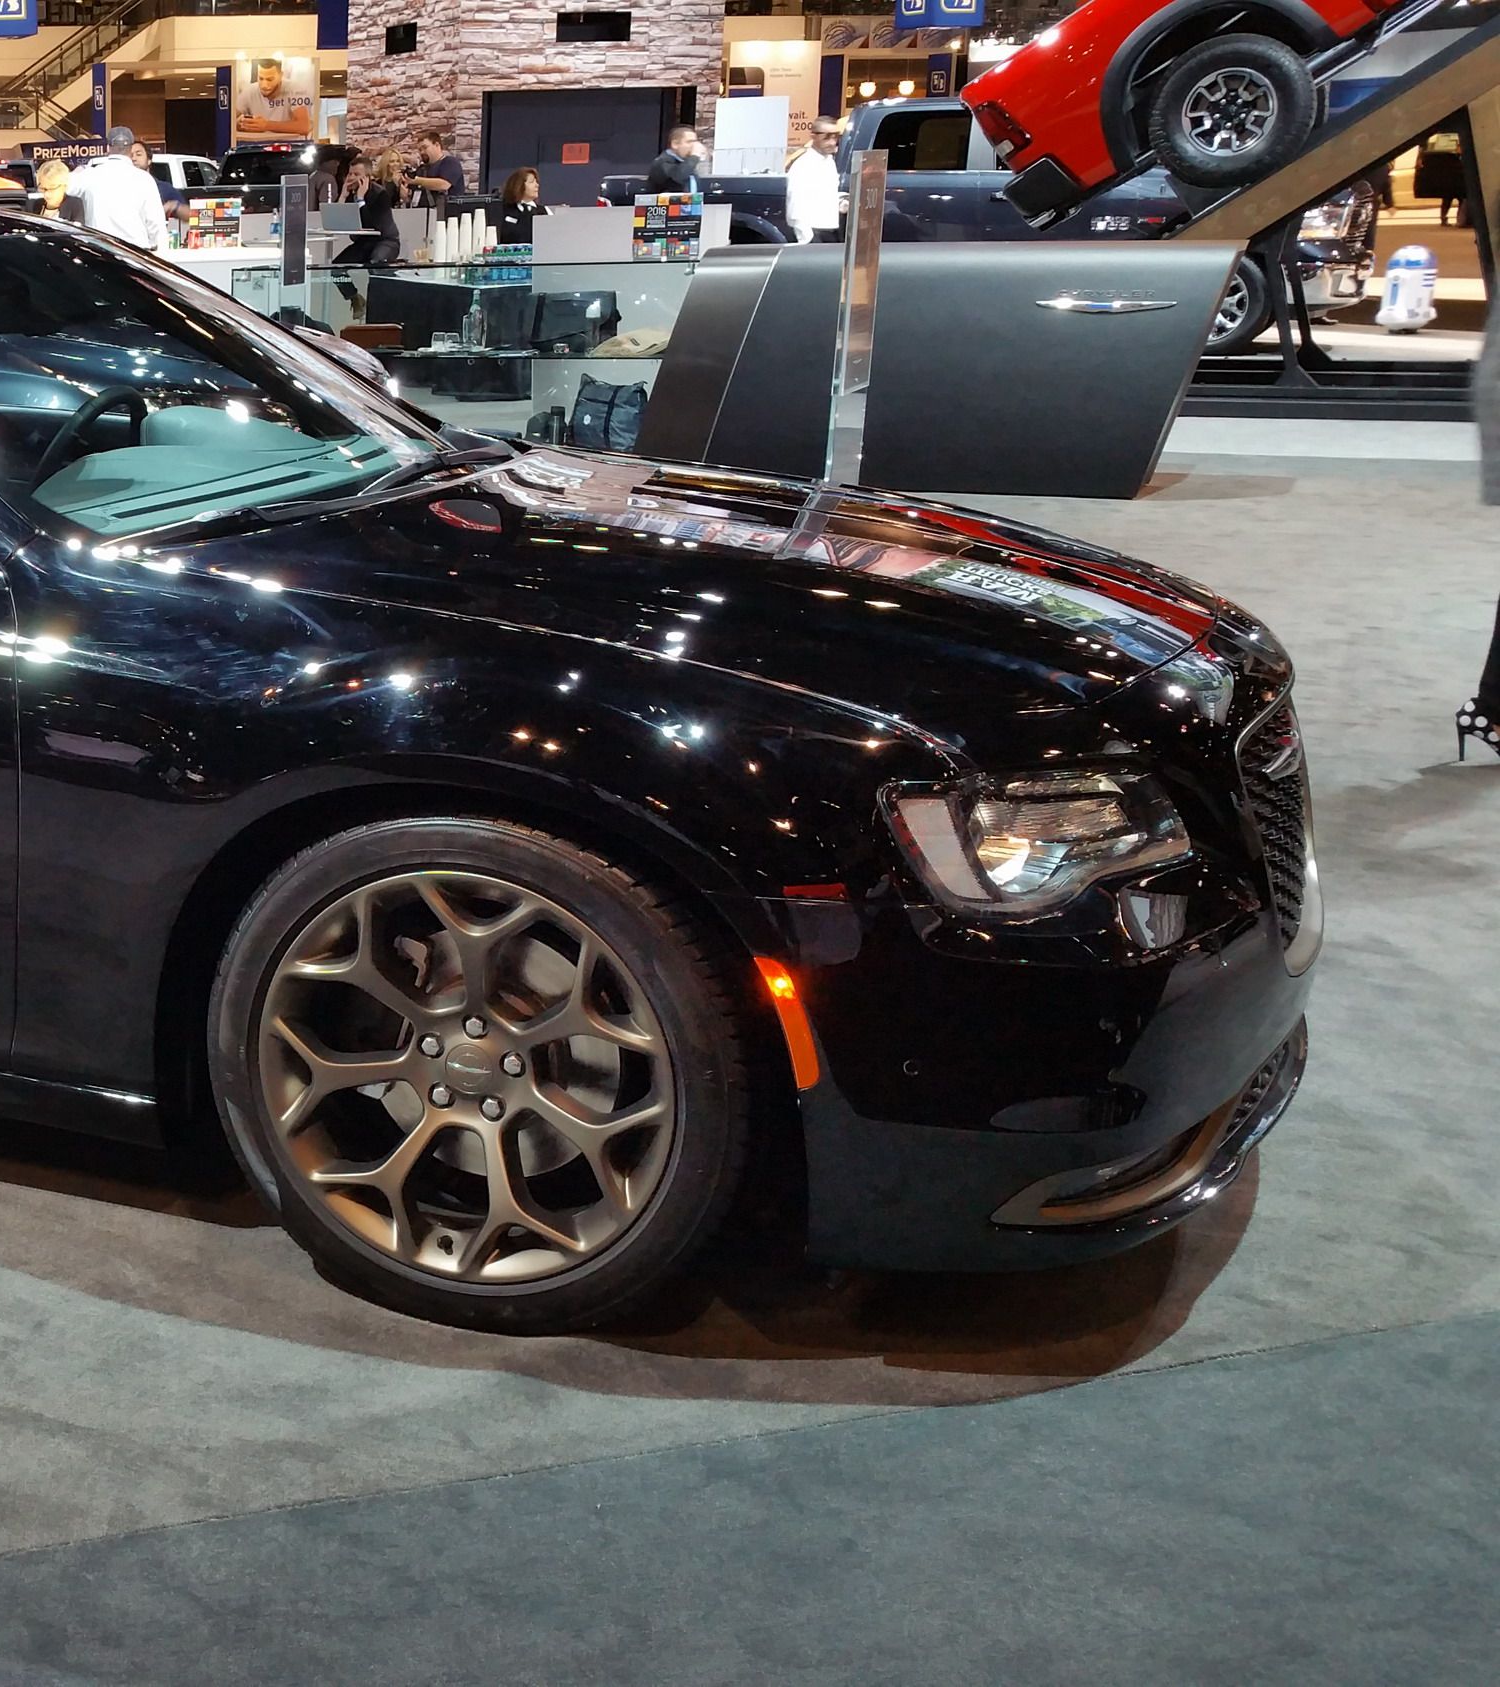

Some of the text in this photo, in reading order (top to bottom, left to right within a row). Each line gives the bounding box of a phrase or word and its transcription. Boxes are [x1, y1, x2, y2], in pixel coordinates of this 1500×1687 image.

[268, 99, 285, 109] get
[33, 144, 110, 159] PRIZEMOBIL
[647, 206, 667, 215] 2016
